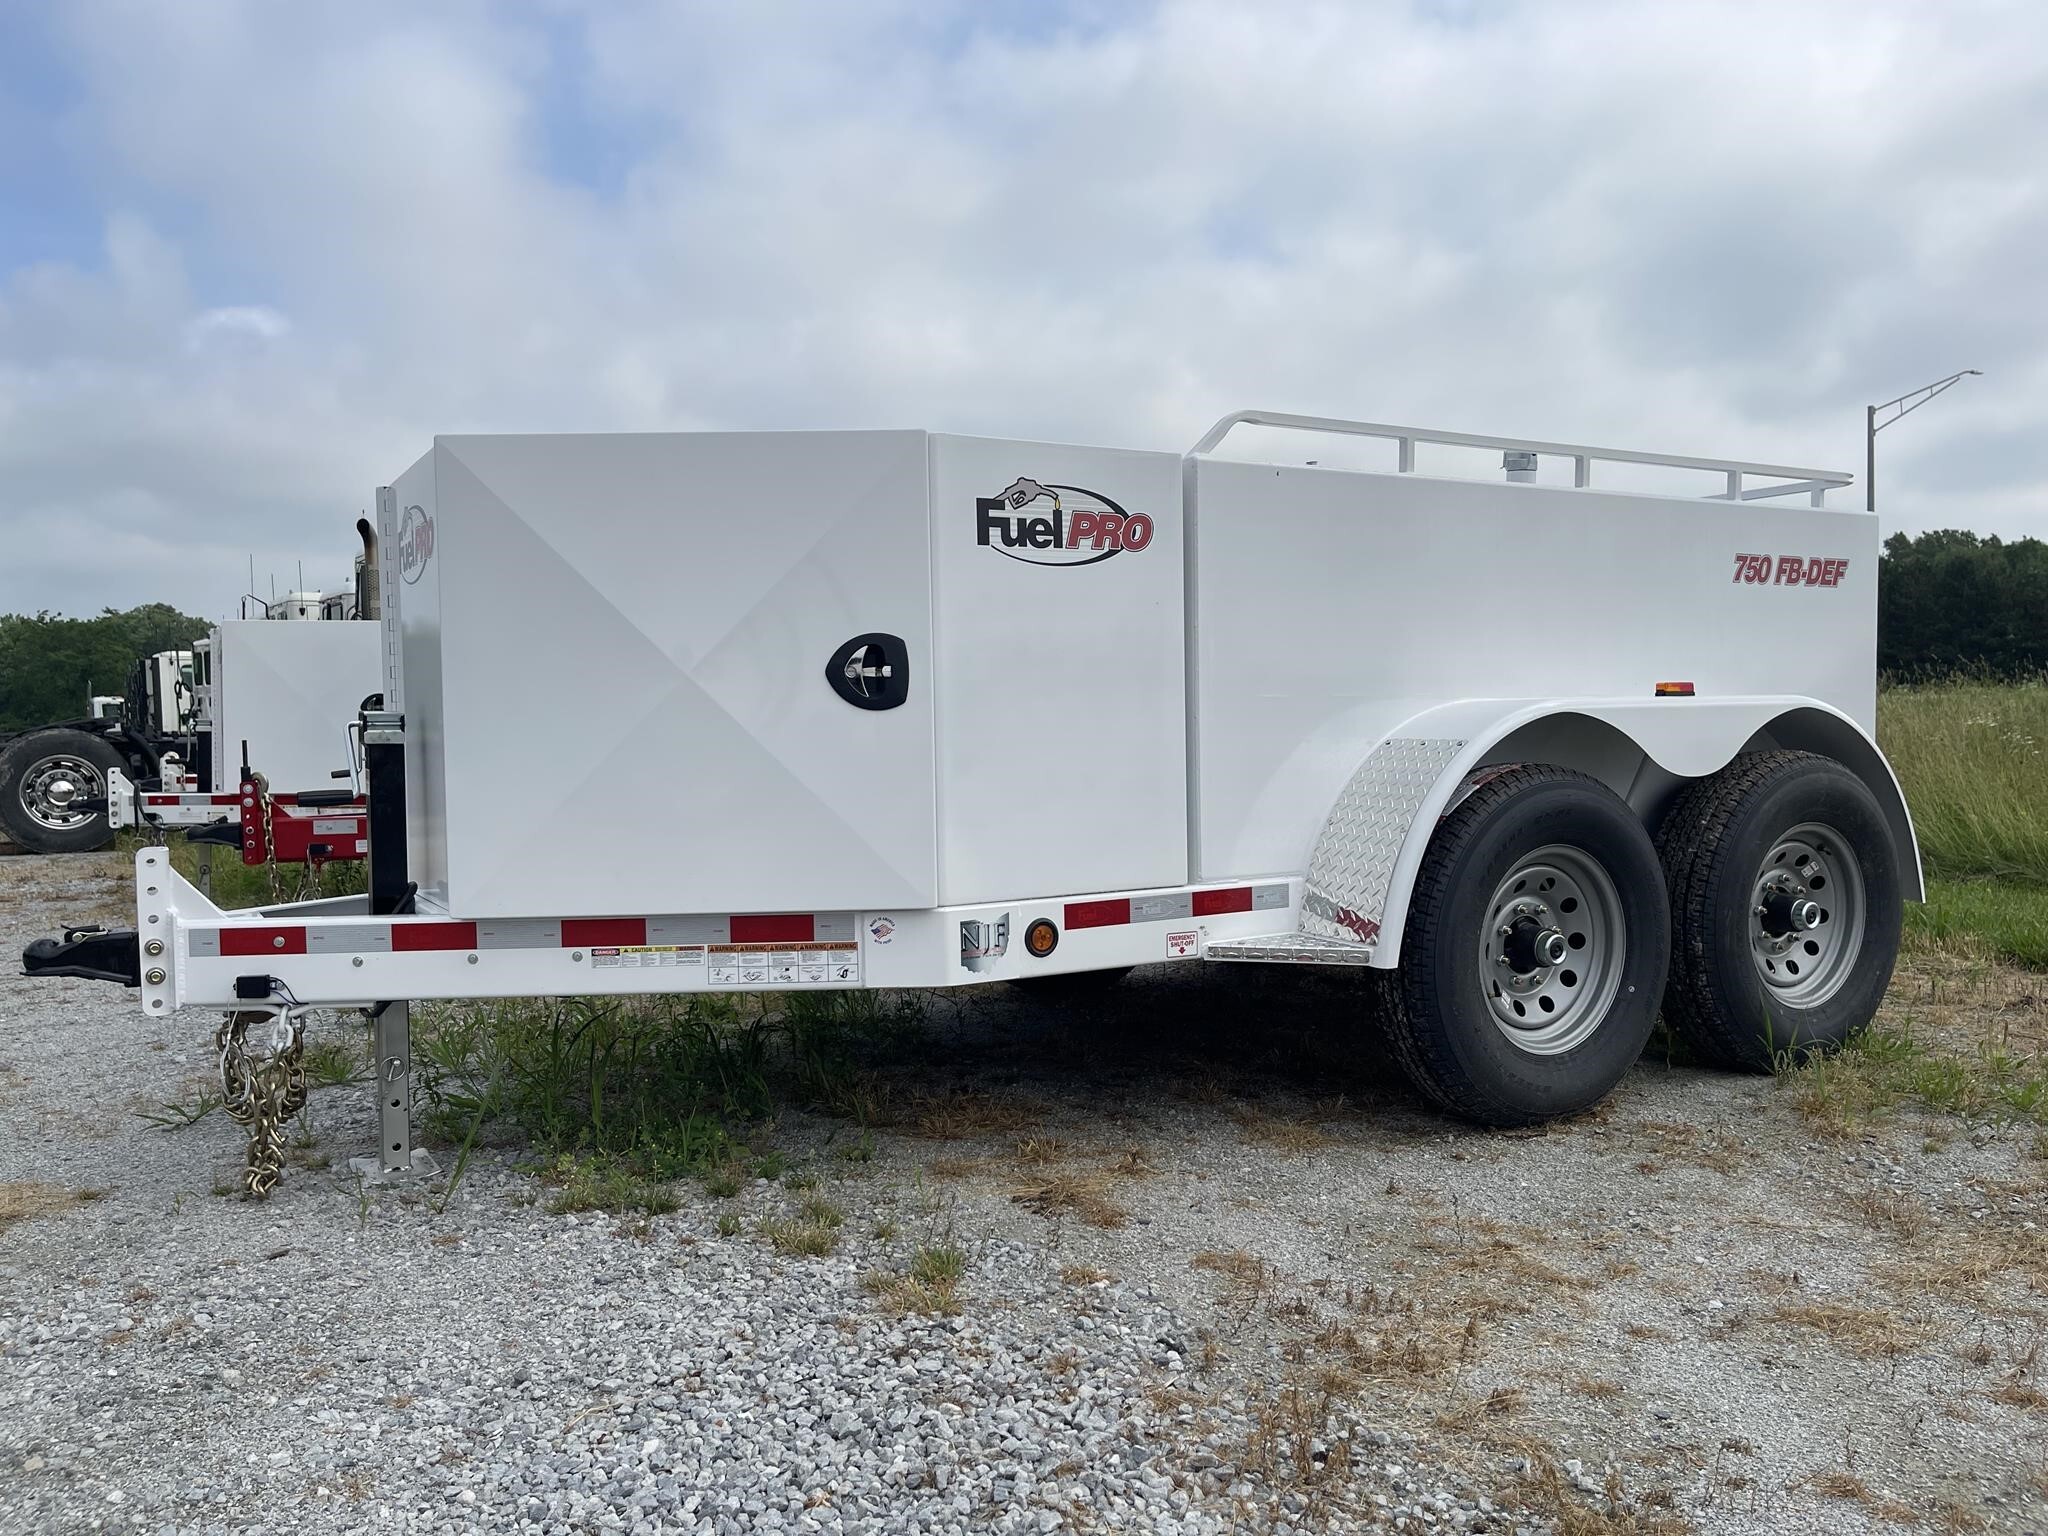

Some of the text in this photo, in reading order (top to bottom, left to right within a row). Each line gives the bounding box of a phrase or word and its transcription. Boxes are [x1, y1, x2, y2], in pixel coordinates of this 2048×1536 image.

[414, 516, 434, 565] PRO
[976, 498, 1154, 552] Fuel PRO
[1733, 553, 1849, 588] 750 FB-DEF
[961, 923, 1005, 957] NJF
[1168, 934, 1195, 942] EMERGENCY
